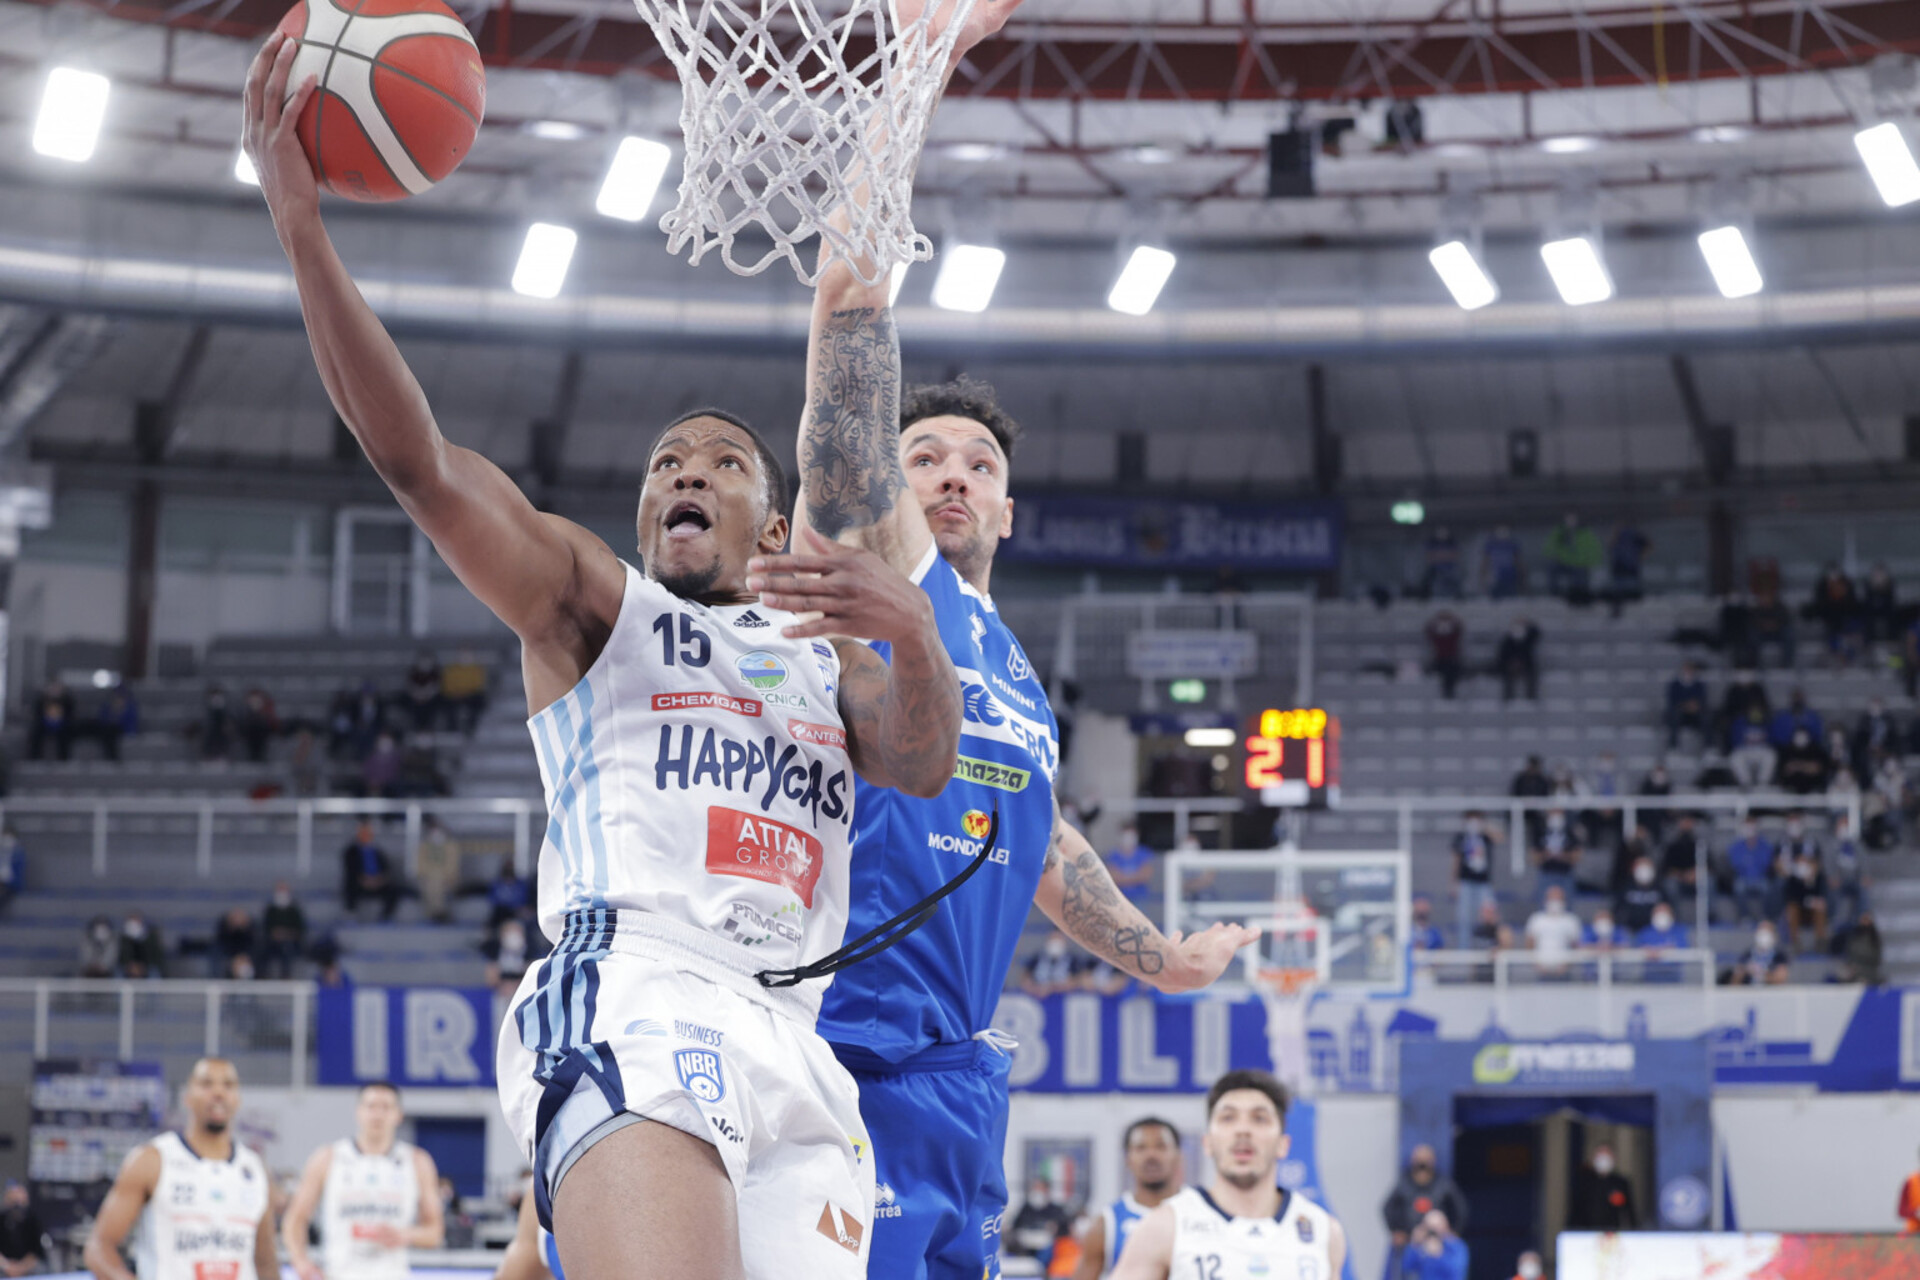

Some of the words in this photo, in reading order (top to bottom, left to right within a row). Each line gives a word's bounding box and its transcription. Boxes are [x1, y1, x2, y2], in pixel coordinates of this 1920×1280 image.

[733, 620, 771, 628] adidas
[653, 612, 711, 668] 15
[657, 694, 757, 714] CHEMGAS
[761, 693, 808, 708] CNICA
[655, 724, 849, 829] HAPPYCAS
[736, 847, 810, 880] GROUP
[674, 1019, 725, 1047] BUSINESS
[874, 1205, 902, 1219] rrea
[1193, 1253, 1223, 1280] 12
